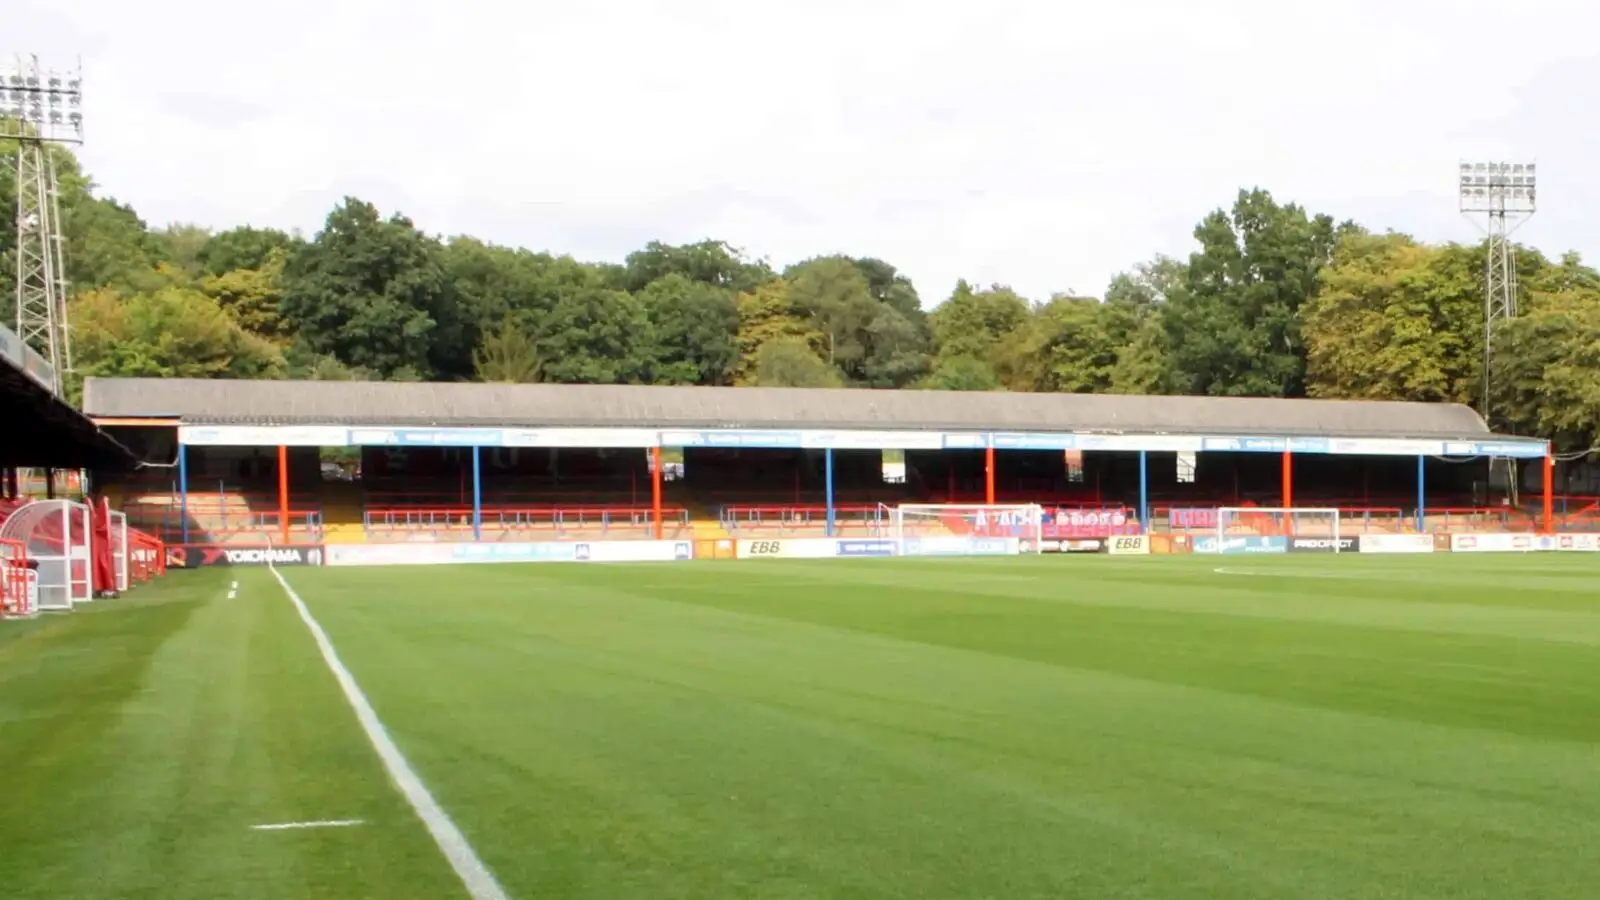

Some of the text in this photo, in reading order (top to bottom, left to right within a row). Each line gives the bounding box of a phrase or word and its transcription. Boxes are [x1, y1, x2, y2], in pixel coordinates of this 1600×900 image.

[750, 541, 780, 554] EBB
[1115, 537, 1142, 549] EBB
[224, 549, 301, 562] YOKOHAMA
